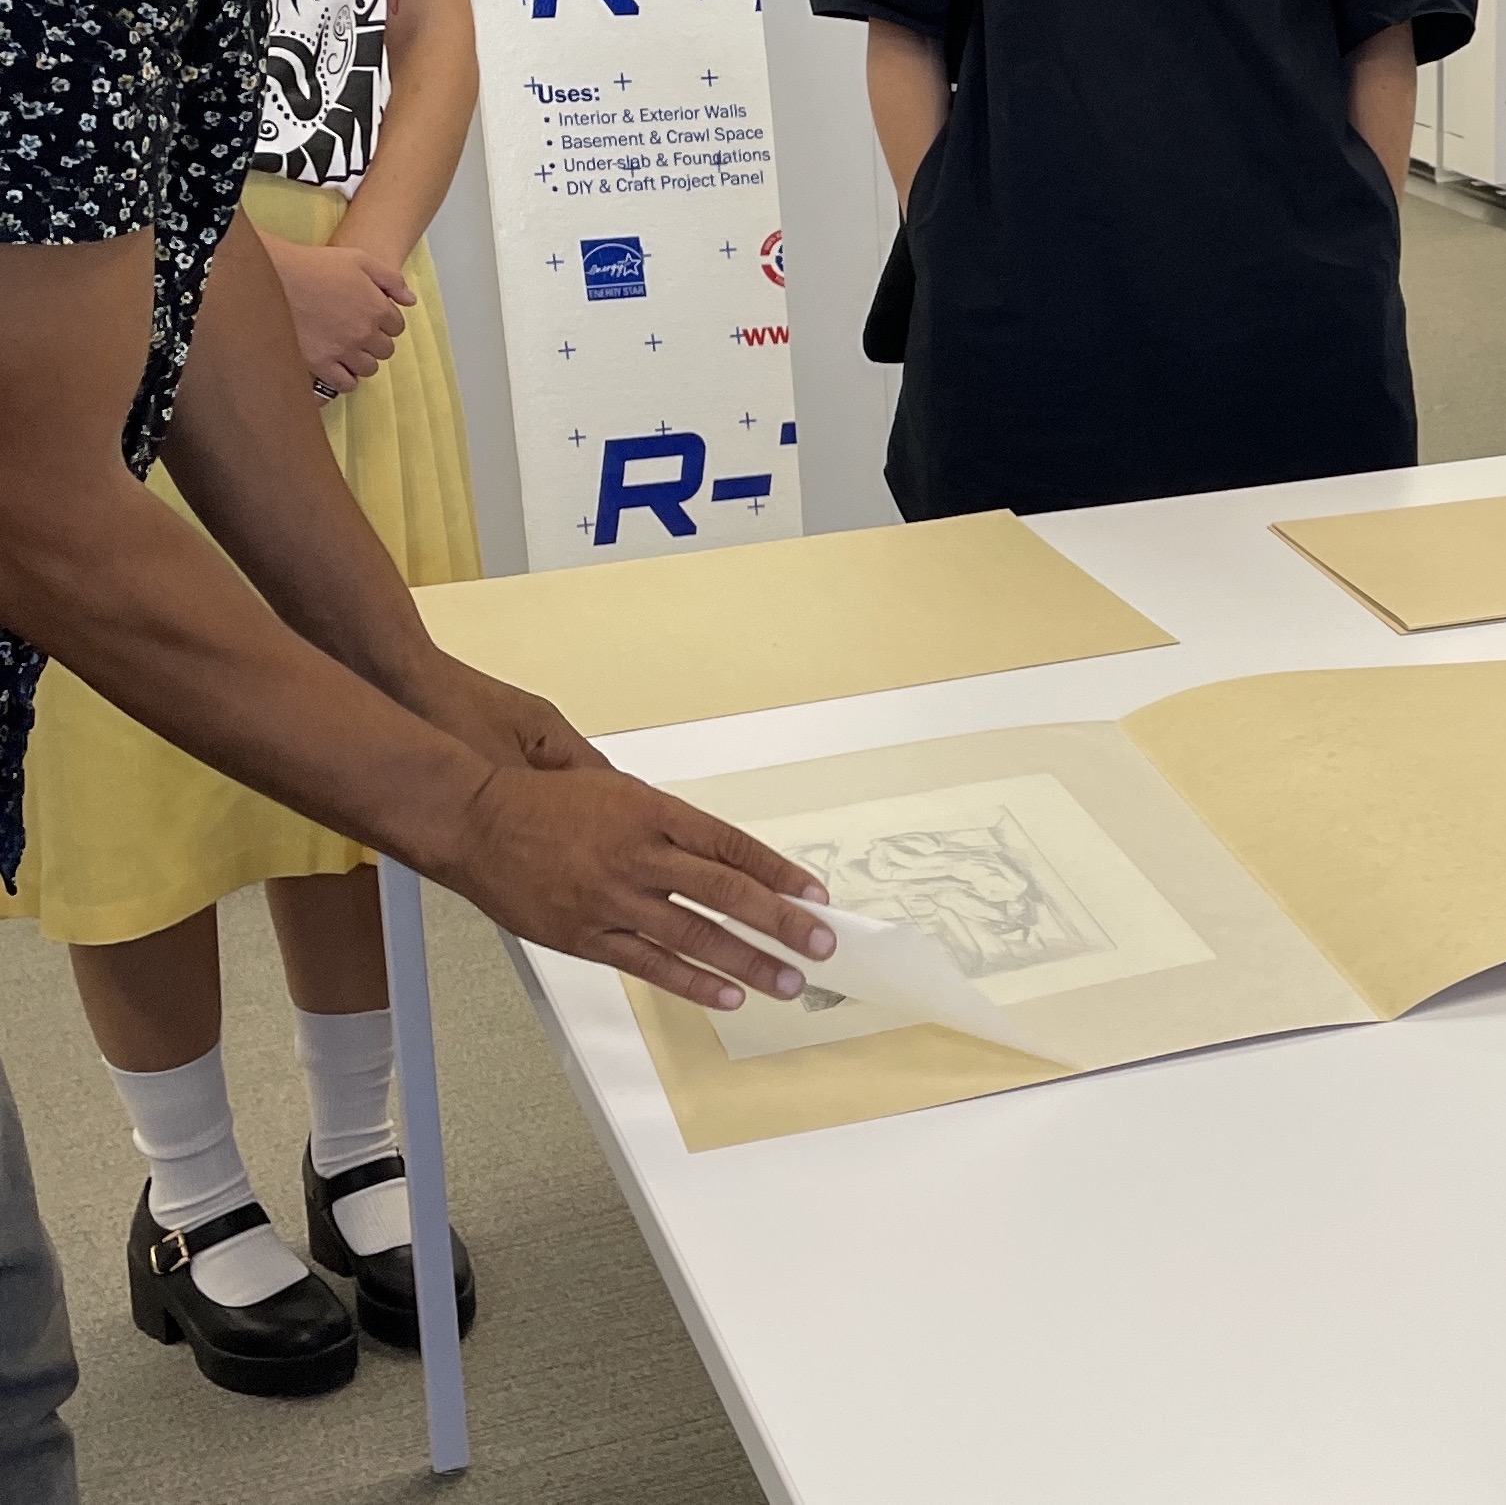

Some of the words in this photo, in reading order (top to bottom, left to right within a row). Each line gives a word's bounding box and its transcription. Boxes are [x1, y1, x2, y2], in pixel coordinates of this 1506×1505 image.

[538, 85, 600, 104] Uses:
[559, 110, 617, 126] Interior
[622, 108, 635, 123] &
[640, 106, 700, 122] Exterior
[704, 104, 747, 119] Walls
[561, 132, 644, 150] Basement
[650, 130, 662, 144] &
[666, 128, 710, 144] Crawl
[714, 126, 764, 143] Space
[564, 154, 651, 172] Under-slab
[656, 153, 669, 167] &
[673, 149, 771, 167] Foundations
[567, 179, 594, 195] DIY
[600, 179, 612, 193] &
[616, 177, 655, 192] Craft
[661, 173, 715, 193] Project
[720, 170, 764, 186] Panel
[593, 420, 797, 546] R-
